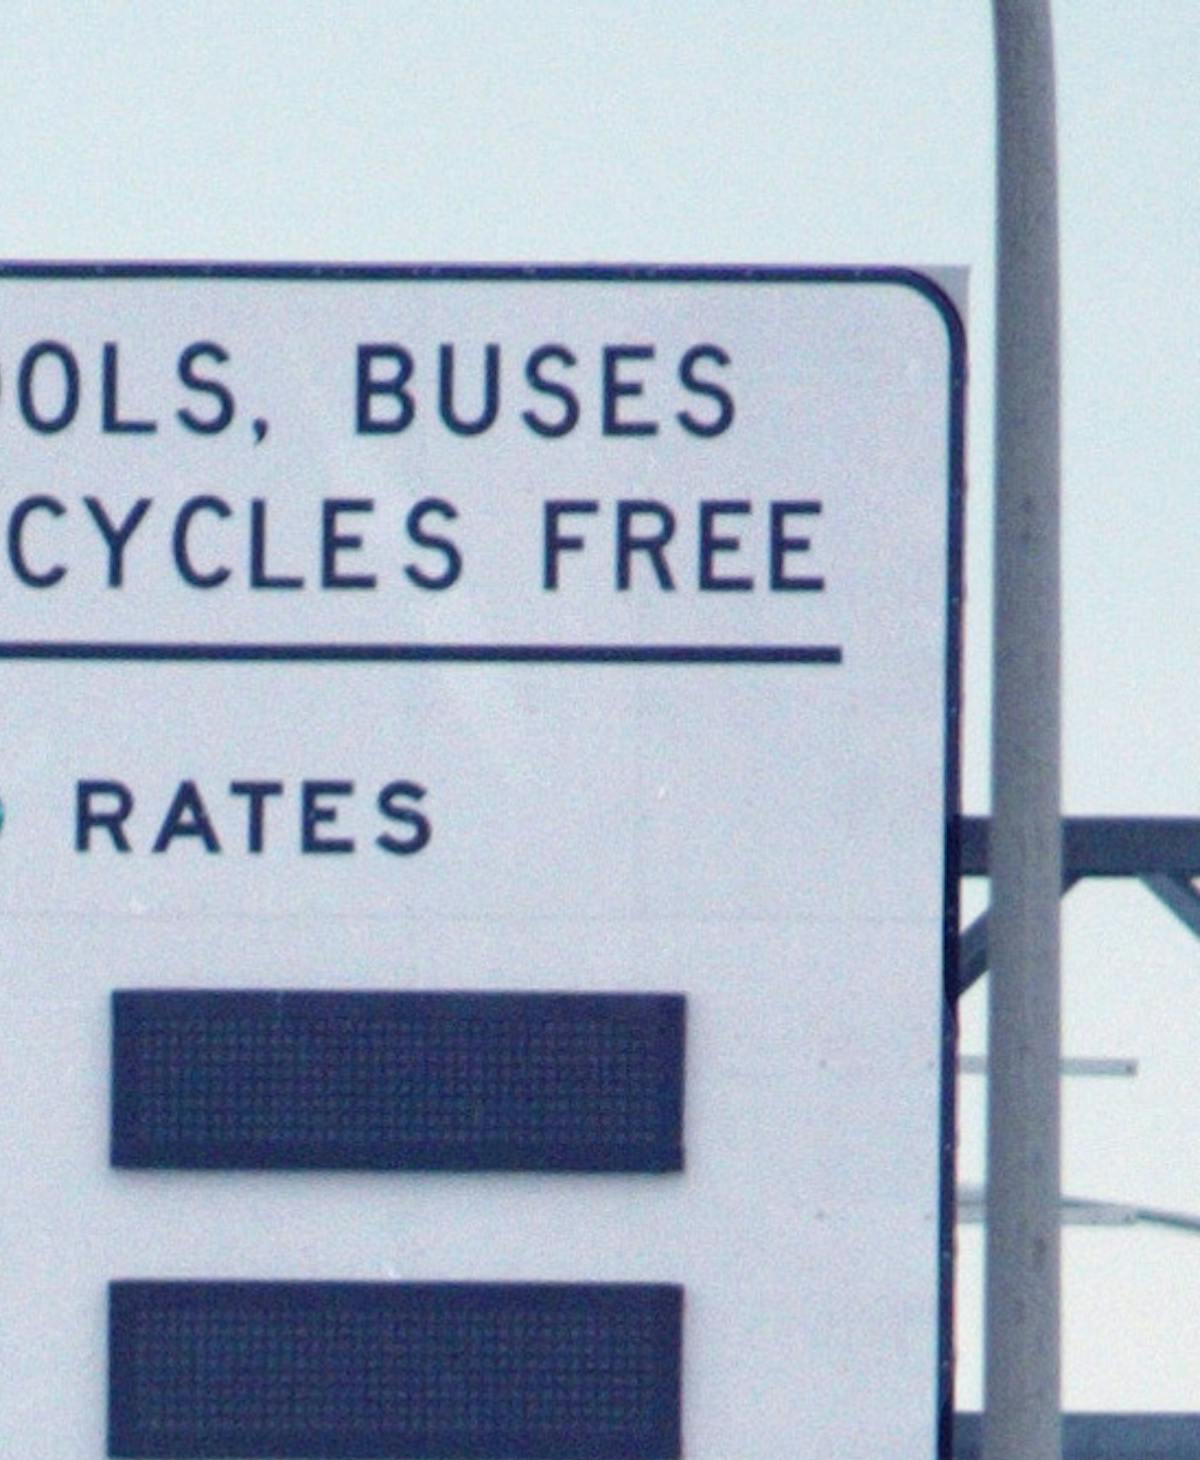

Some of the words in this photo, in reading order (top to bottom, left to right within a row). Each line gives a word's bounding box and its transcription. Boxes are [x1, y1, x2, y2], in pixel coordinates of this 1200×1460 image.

[354, 342, 736, 440] BUSES
[542, 498, 827, 594] FREE
[74, 779, 432, 858] RATES
